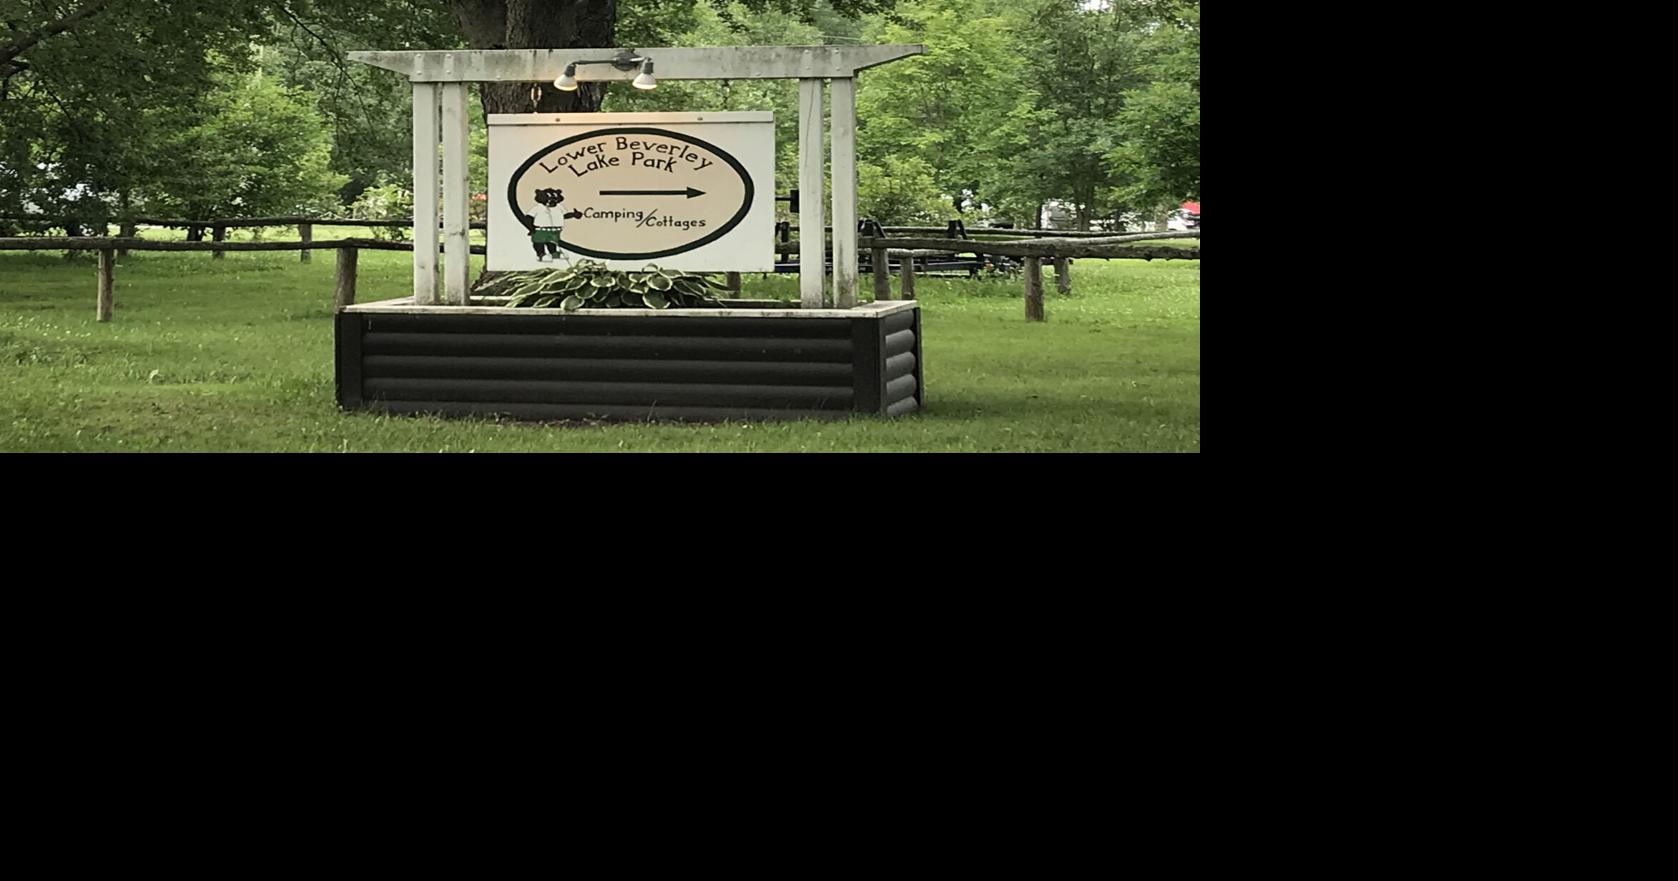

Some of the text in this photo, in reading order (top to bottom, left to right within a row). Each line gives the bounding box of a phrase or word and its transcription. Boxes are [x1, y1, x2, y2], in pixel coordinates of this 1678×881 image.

[539, 136, 714, 174] Lower Beverley
[568, 151, 678, 177] Lake Park
